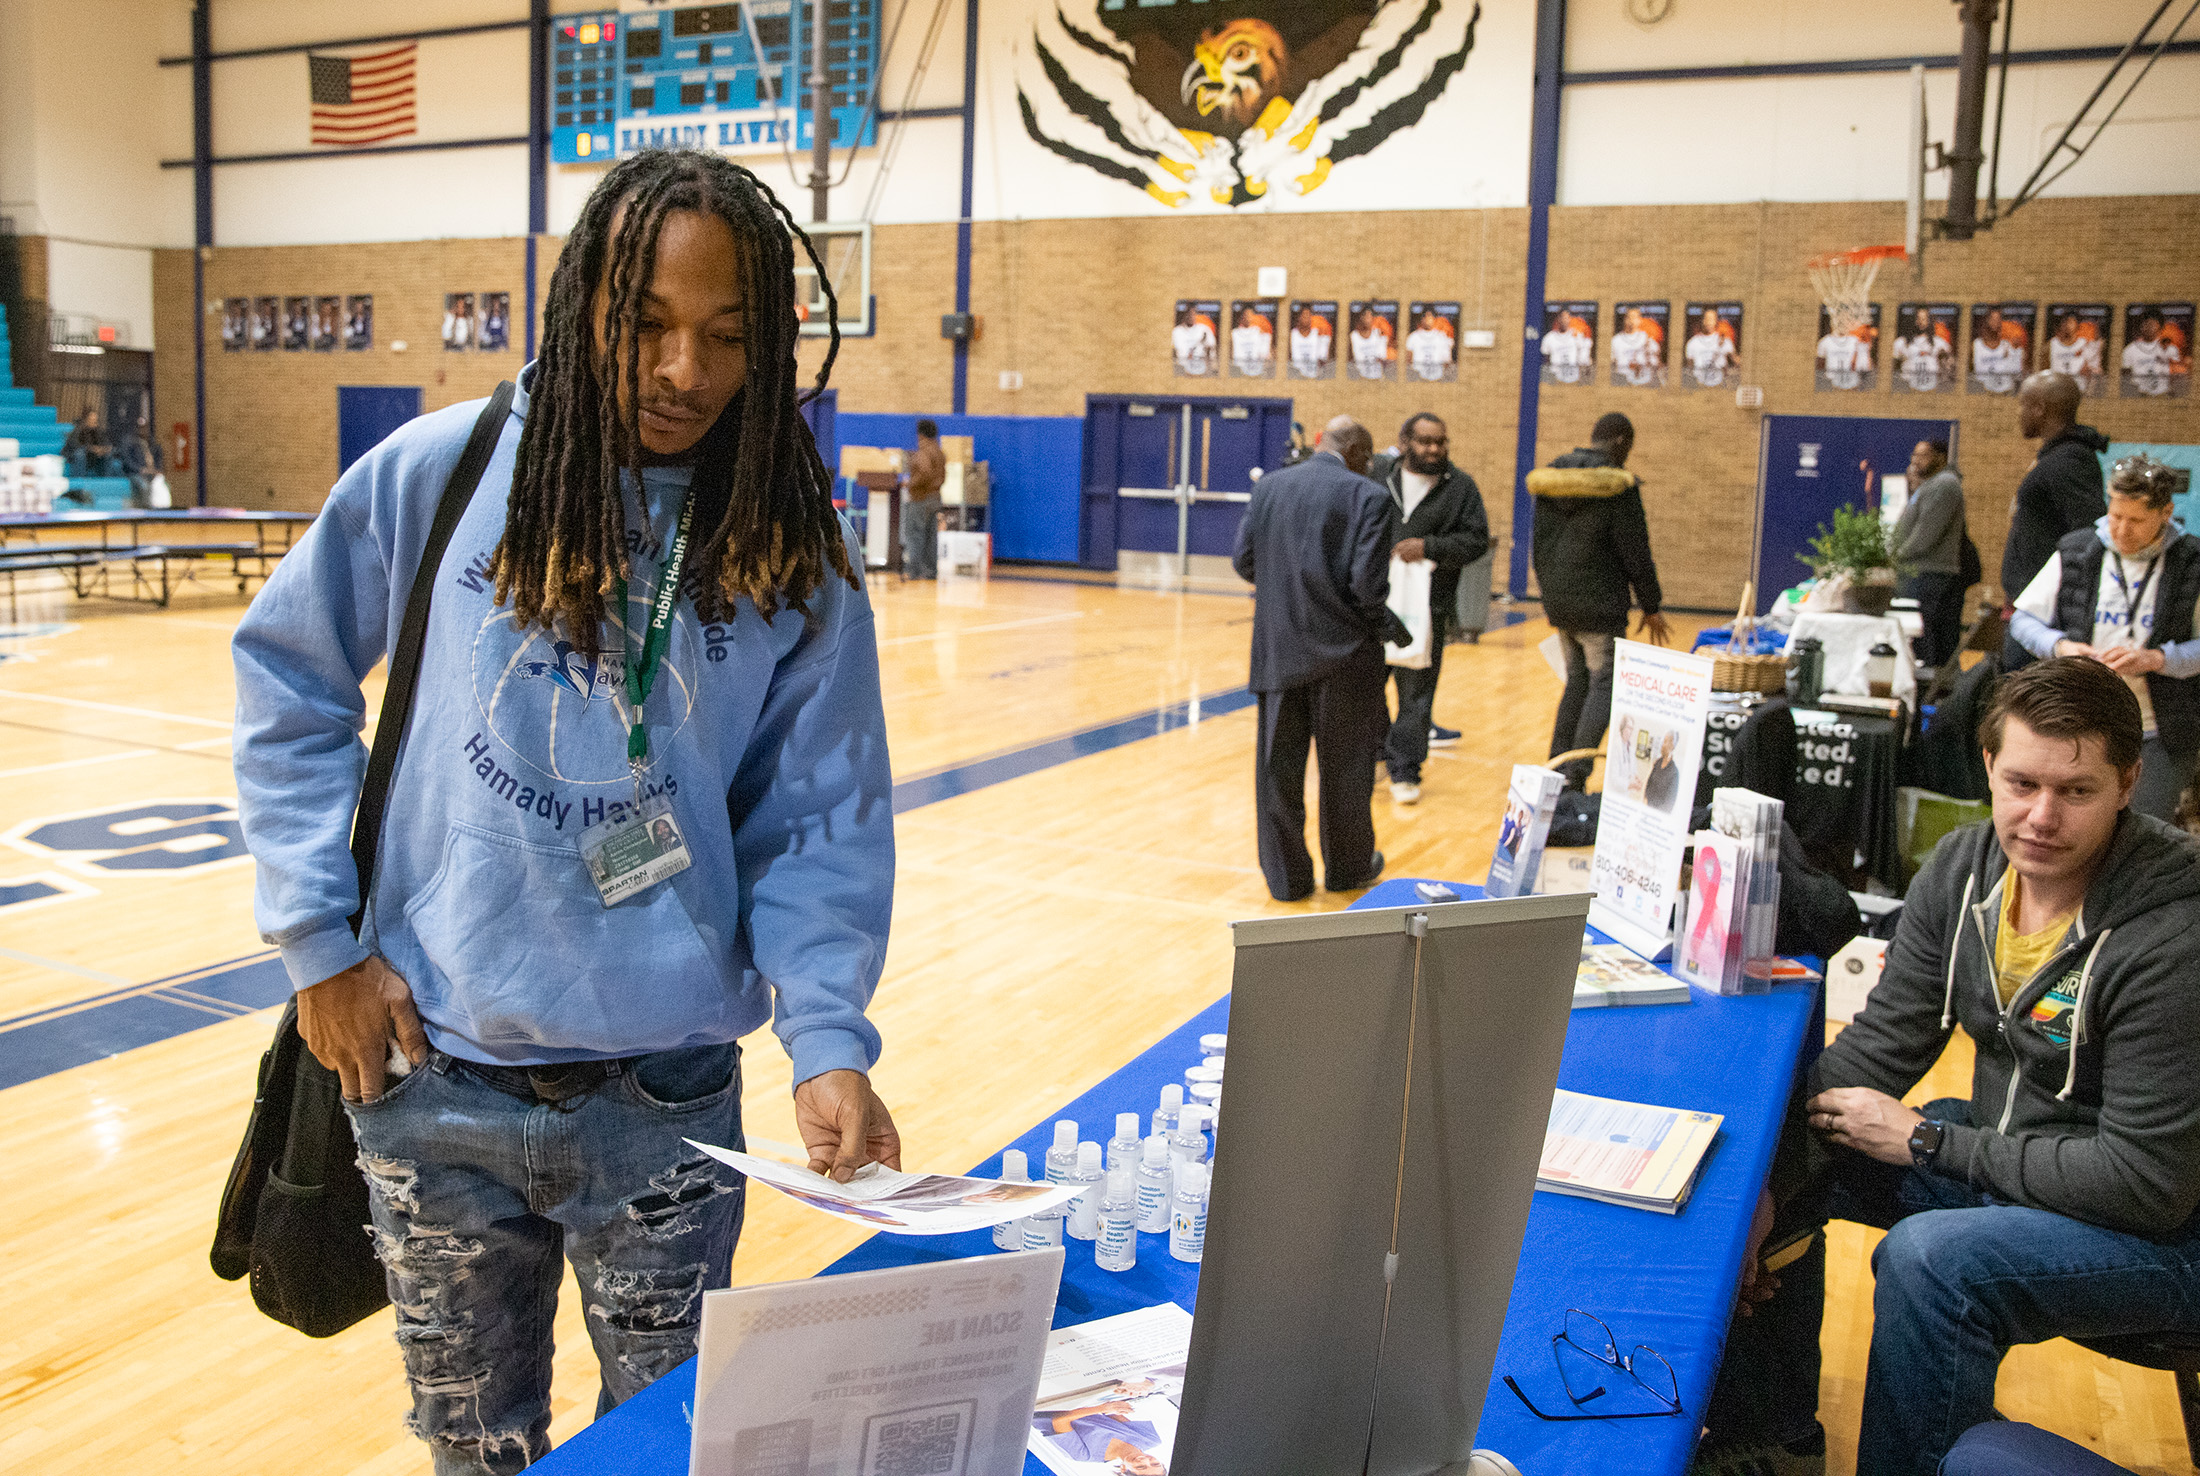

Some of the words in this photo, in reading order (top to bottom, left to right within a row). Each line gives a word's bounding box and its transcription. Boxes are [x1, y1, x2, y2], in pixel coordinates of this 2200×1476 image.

[652, 582, 676, 630] Public
[665, 534, 689, 583] Health
[1619, 670, 1665, 695] MEDICAL
[1667, 681, 1698, 703] CARE
[464, 732, 573, 831] Hamady
[601, 869, 648, 896] SPARTAN
[1596, 854, 1663, 898] 810-406-4246
